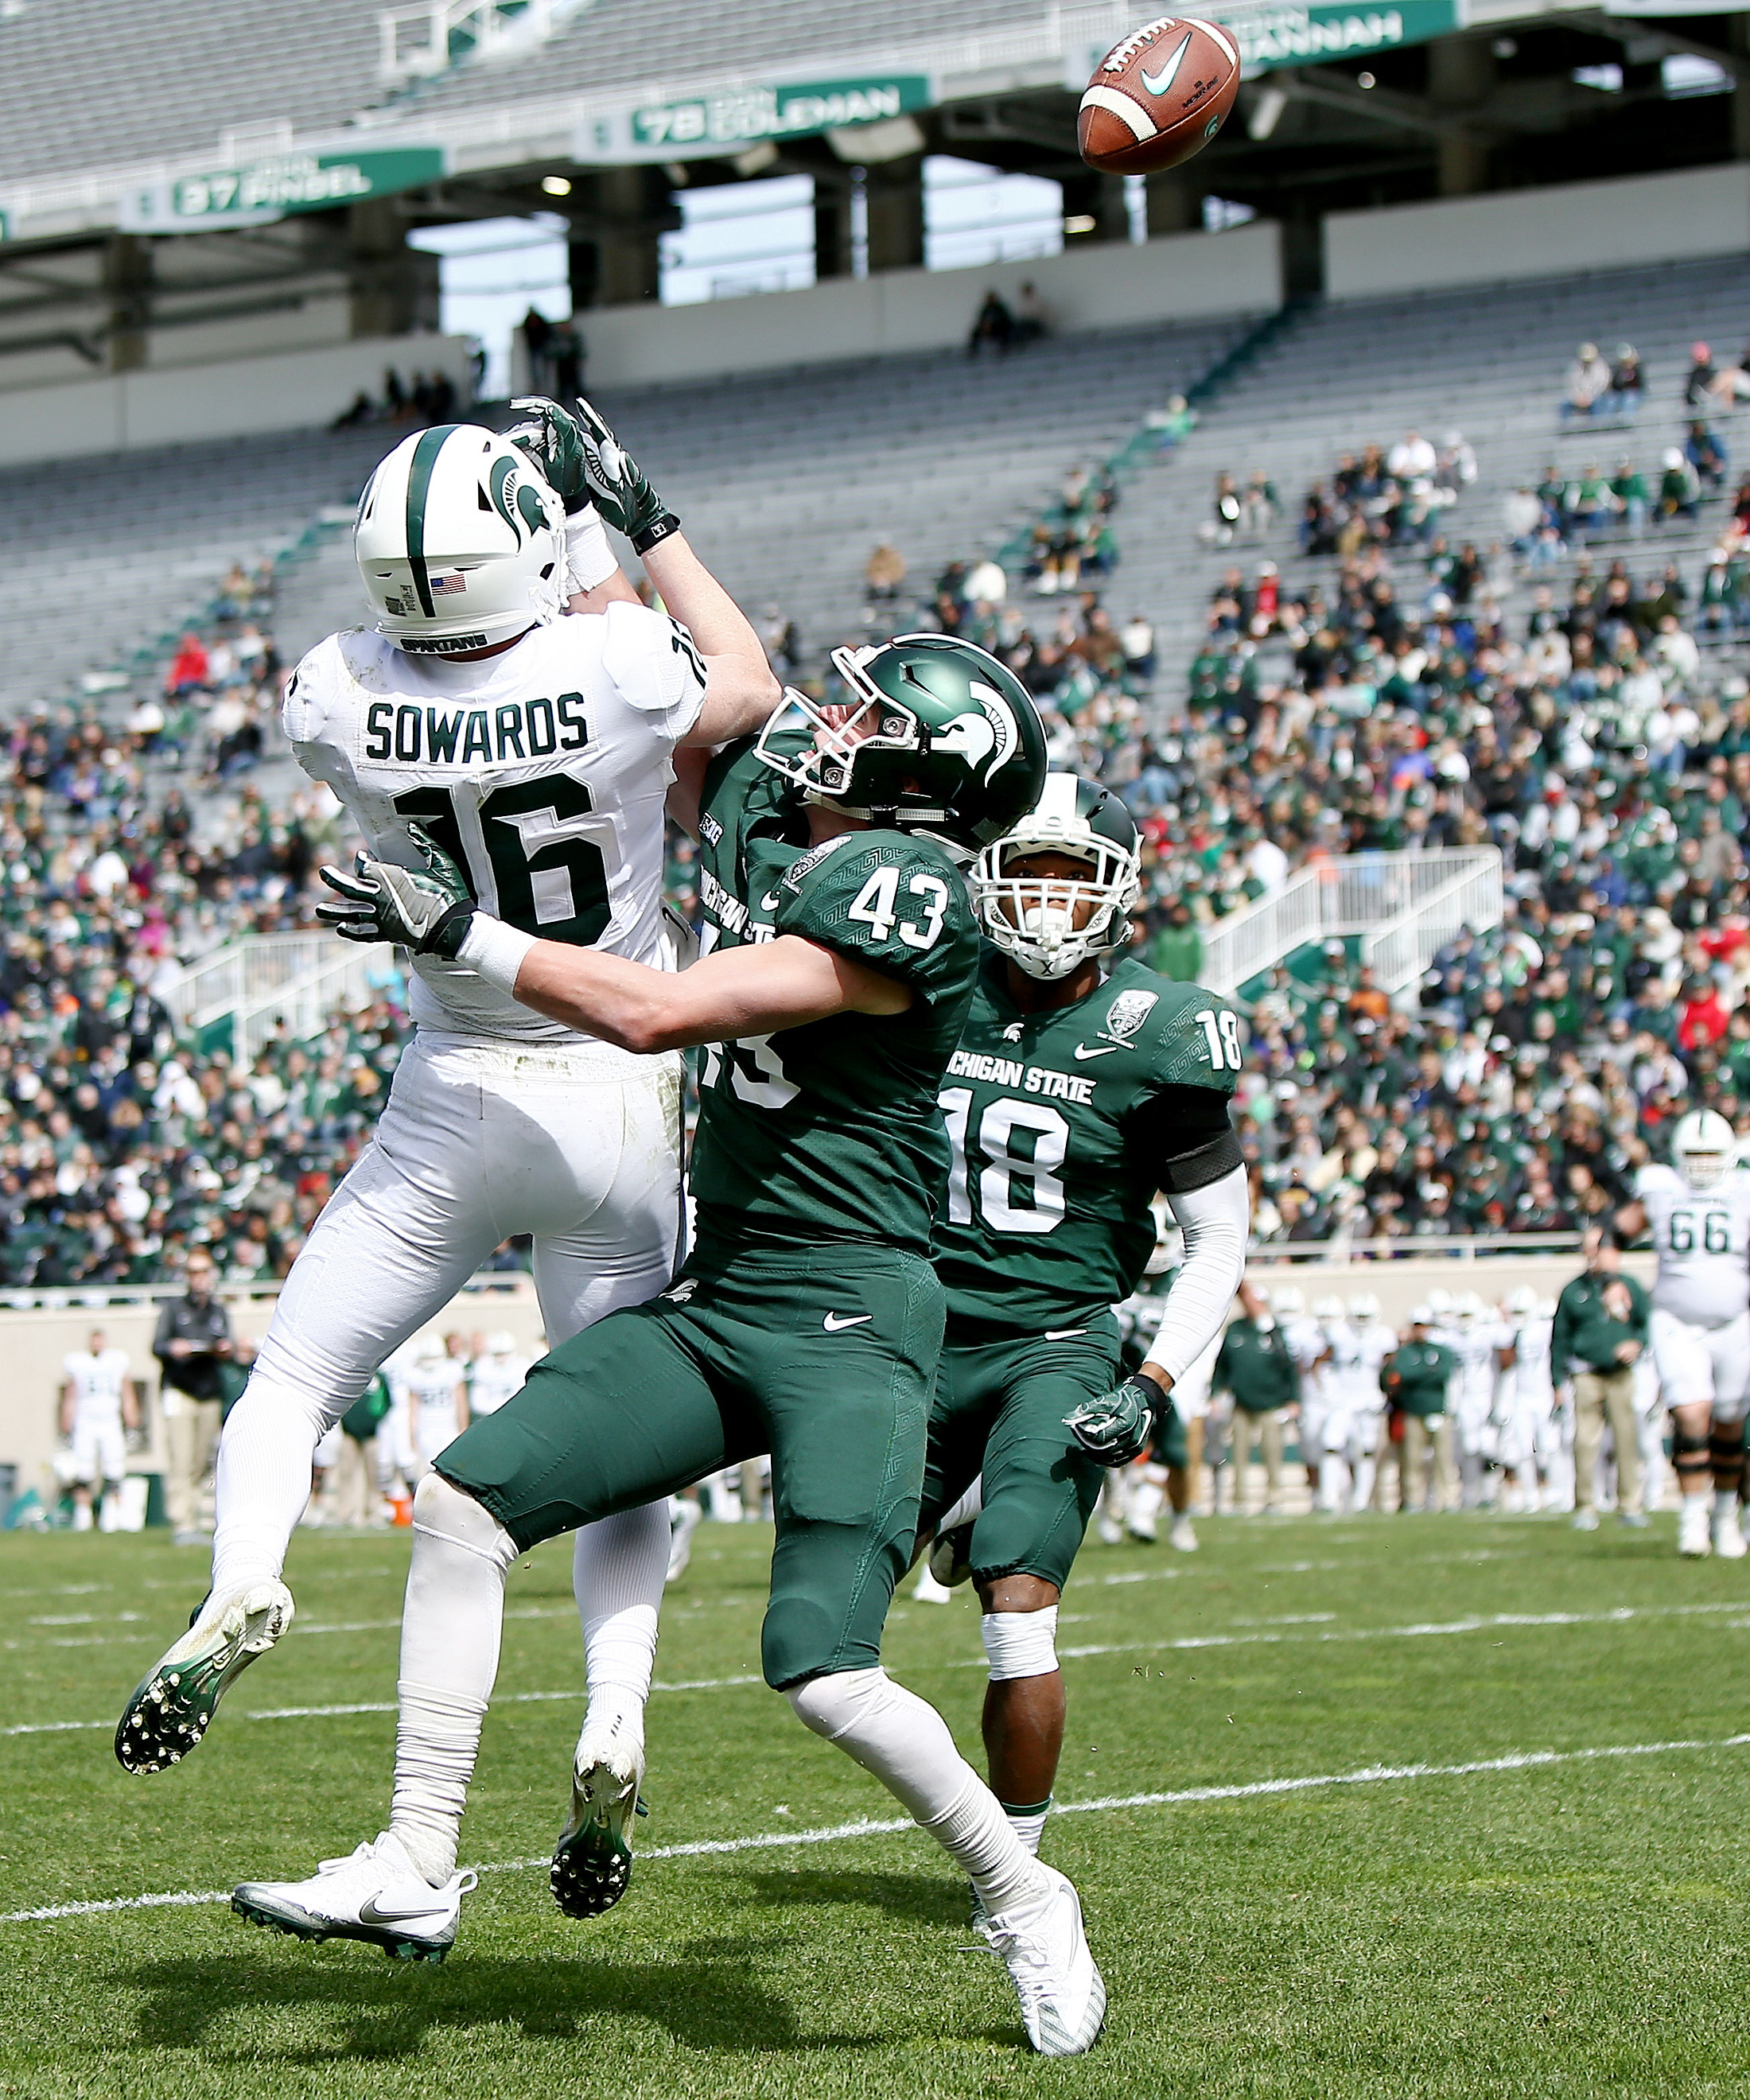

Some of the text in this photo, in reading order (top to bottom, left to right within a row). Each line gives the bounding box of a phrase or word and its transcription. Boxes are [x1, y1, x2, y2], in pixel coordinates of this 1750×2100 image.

[641, 104, 706, 144] 78
[181, 177, 238, 216] 37
[399, 633, 488, 652] SPARTANS
[366, 691, 589, 764] SOWARDS
[846, 865, 949, 951] 43
[1195, 1009, 1242, 1071] 18
[1024, 1066, 1098, 1106] STATE
[936, 1087, 1070, 1233] 18
[1670, 1211, 1731, 1255] 66
